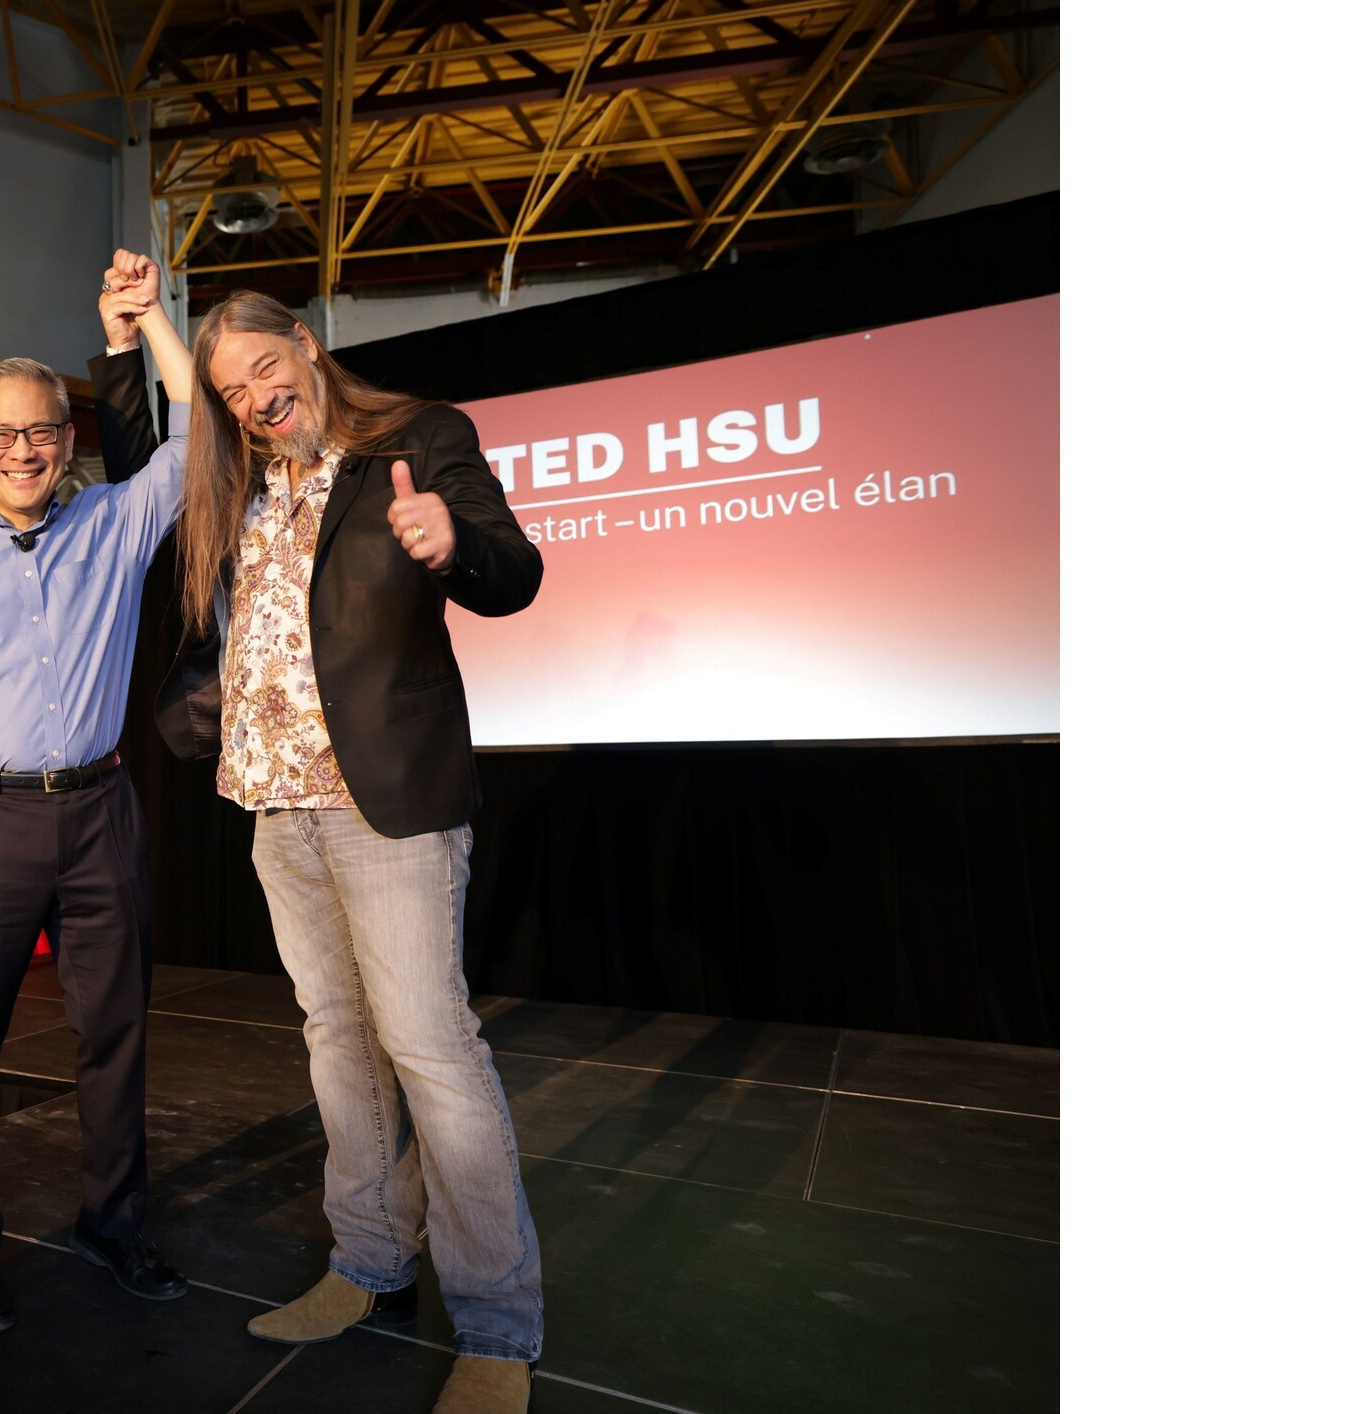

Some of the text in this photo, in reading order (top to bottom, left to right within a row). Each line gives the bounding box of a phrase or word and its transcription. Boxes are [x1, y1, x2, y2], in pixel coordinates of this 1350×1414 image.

[485, 397, 821, 493] TED HSU
[525, 509, 608, 544] start
[699, 477, 840, 526] nouvel
[854, 470, 957, 507] élan
